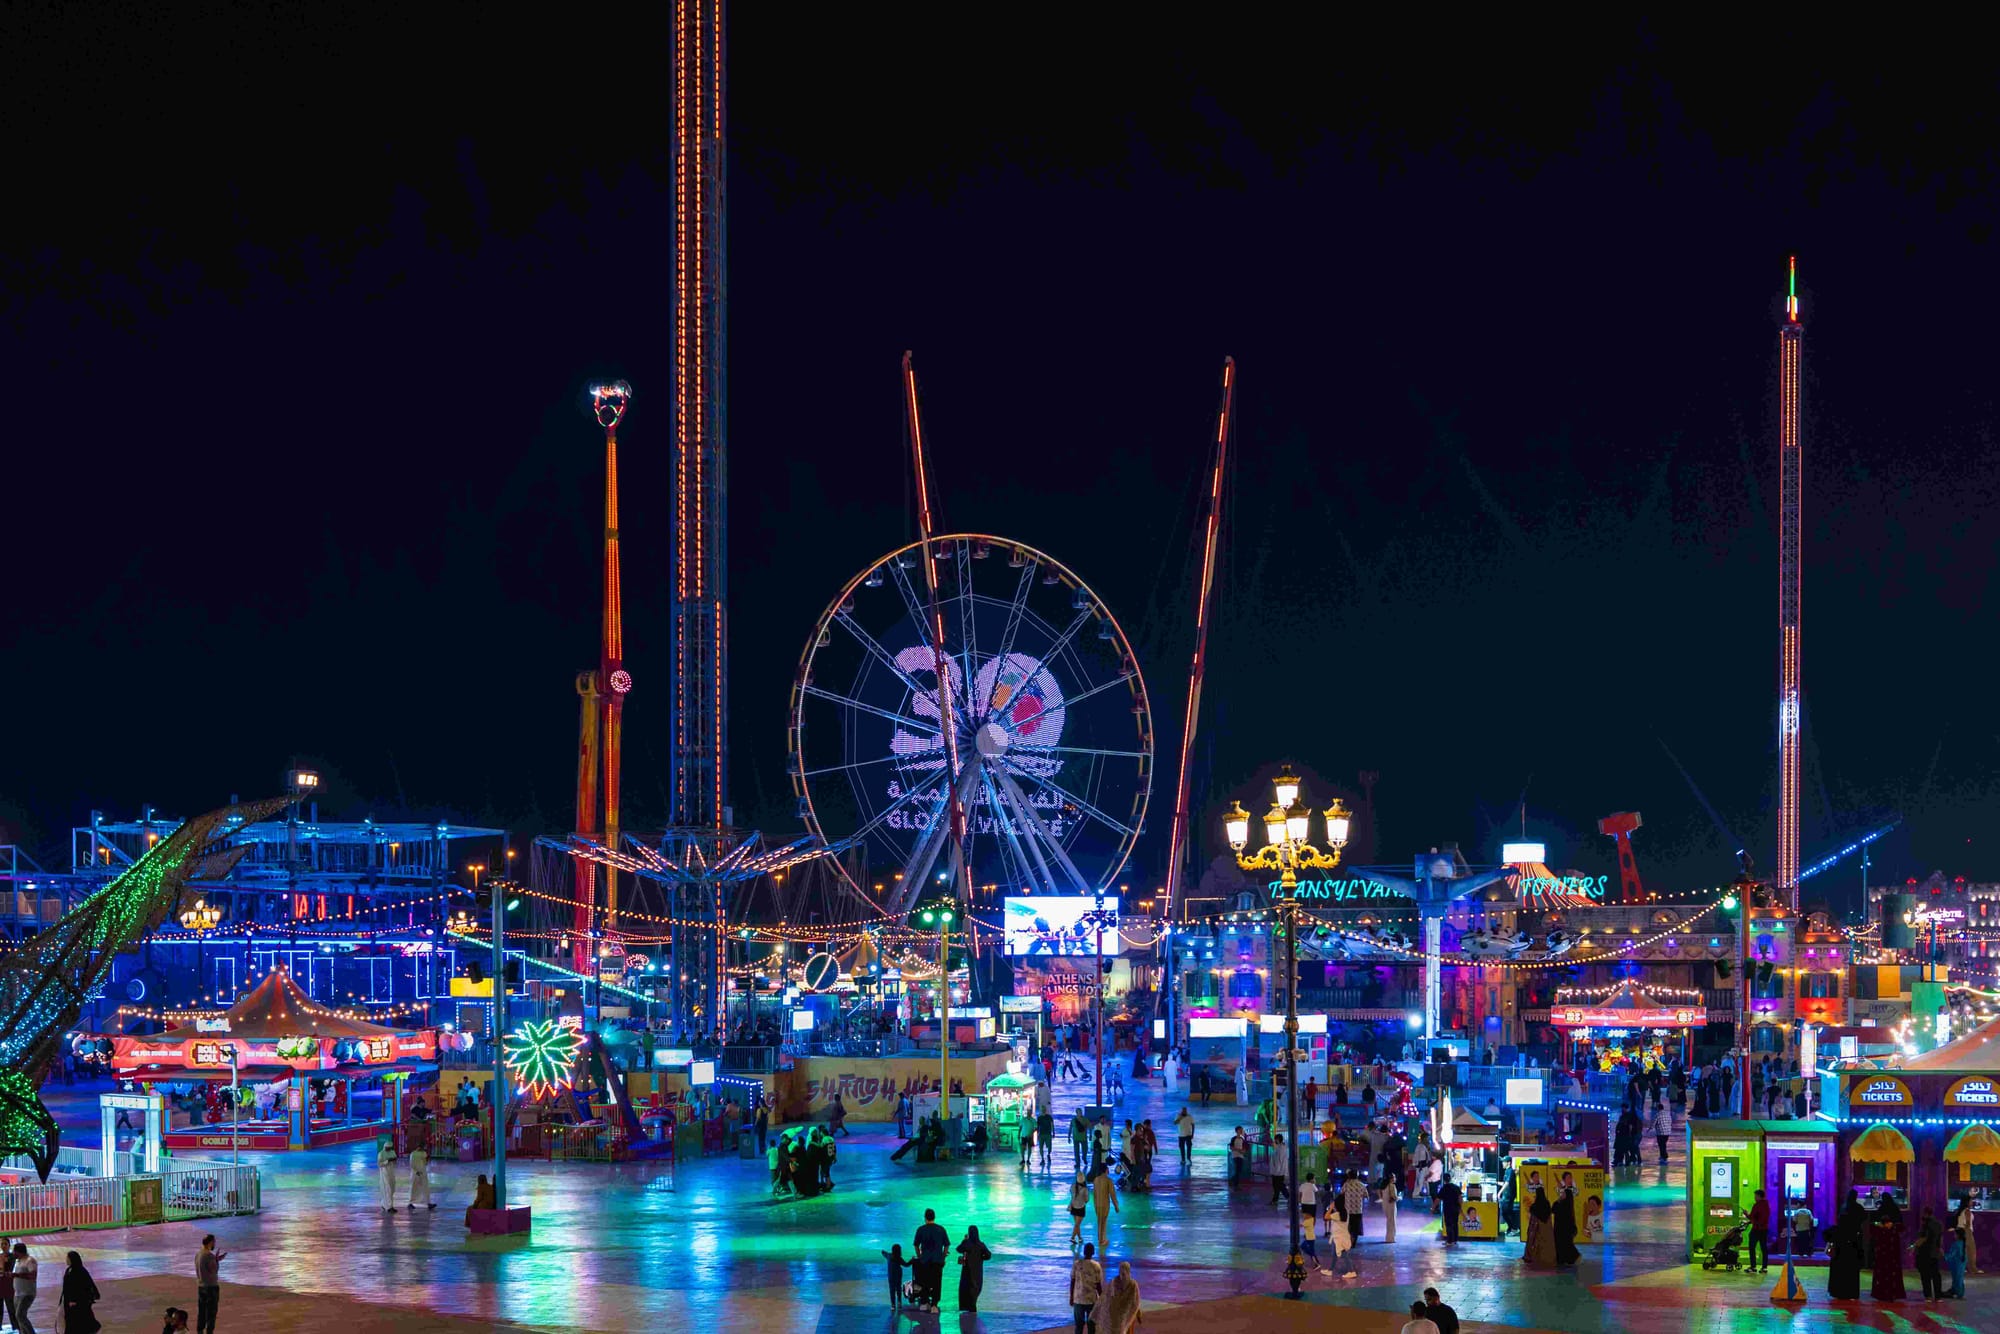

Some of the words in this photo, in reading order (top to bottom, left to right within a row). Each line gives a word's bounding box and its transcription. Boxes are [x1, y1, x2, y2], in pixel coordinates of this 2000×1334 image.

[1520, 875, 1608, 899] TOWERS
[1047, 973, 1094, 984] ATHENS
[1868, 1081, 1896, 1092] تذاكر
[1962, 1082, 1991, 1093] تذاكر
[1861, 1093, 1903, 1102] TICKETS
[1954, 1093, 1998, 1103] TICKETS
